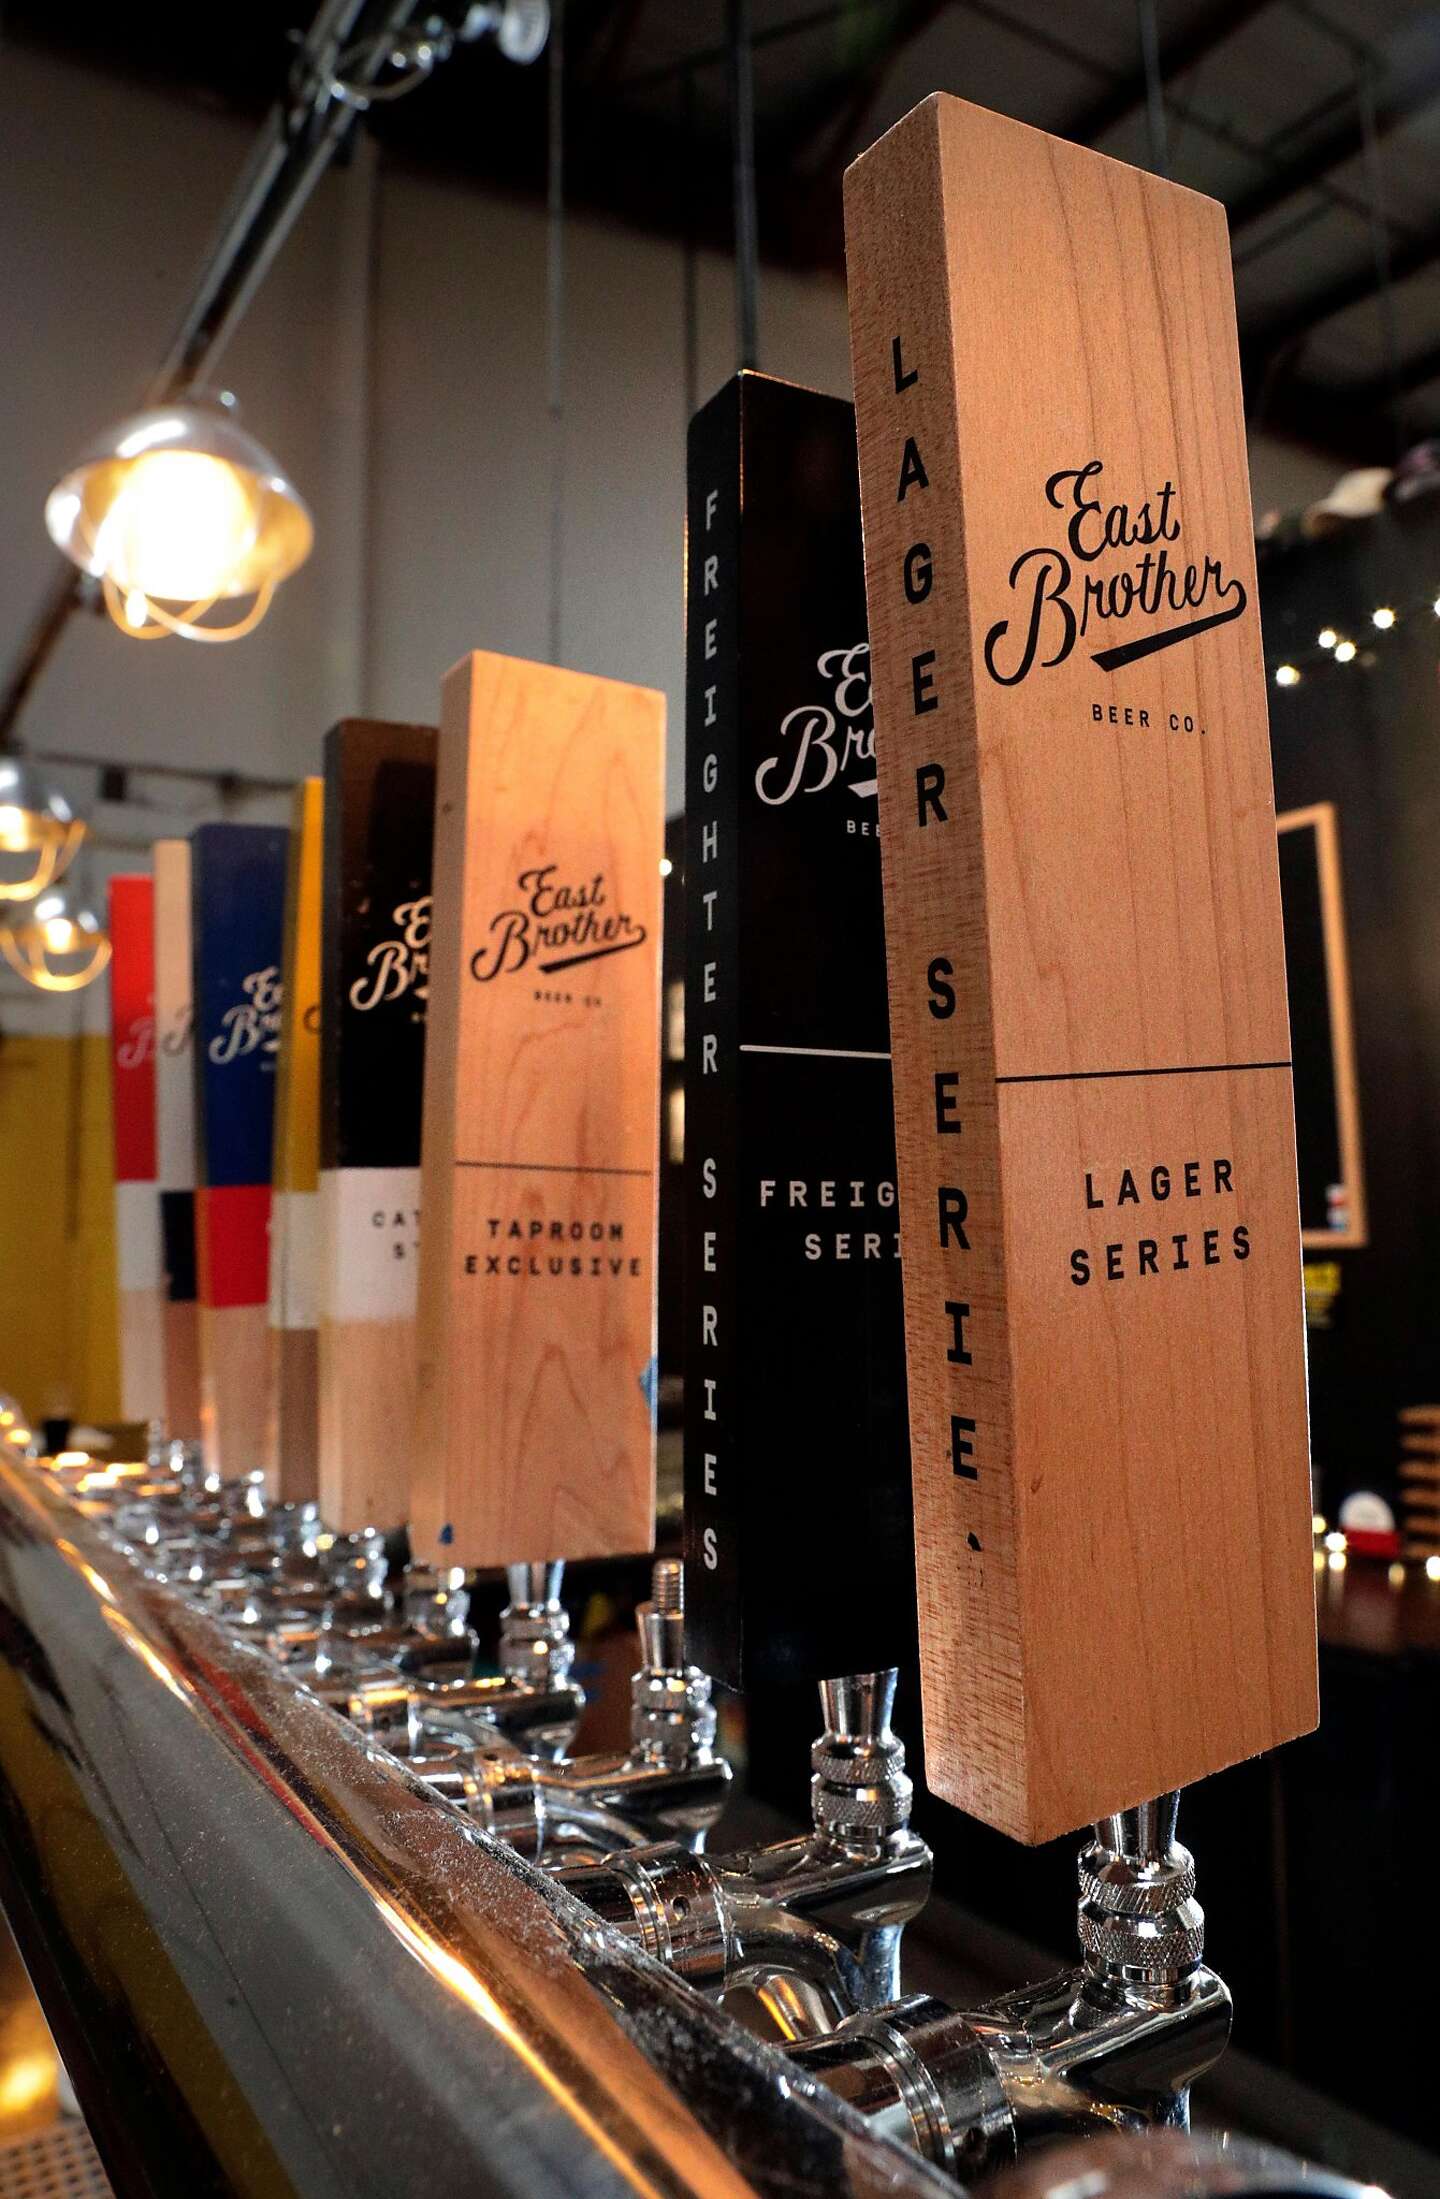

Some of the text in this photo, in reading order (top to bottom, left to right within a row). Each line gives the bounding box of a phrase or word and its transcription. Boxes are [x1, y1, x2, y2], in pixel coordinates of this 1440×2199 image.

[1045, 460, 1181, 562] East
[984, 547, 1247, 686] Brother
[1092, 704, 1206, 735] BEER CO.
[518, 865, 606, 917] East
[470, 910, 647, 982] Brother
[892, 336, 982, 1551] LAGER SERIE
[702, 490, 719, 1571] FREIGHTER SERIES
[1085, 1158, 1235, 1210] LAGER
[487, 1219, 623, 1241] TAPROOM
[1070, 1225, 1251, 1286] SERIES
[464, 1254, 641, 1277] EXCLUSIVE
